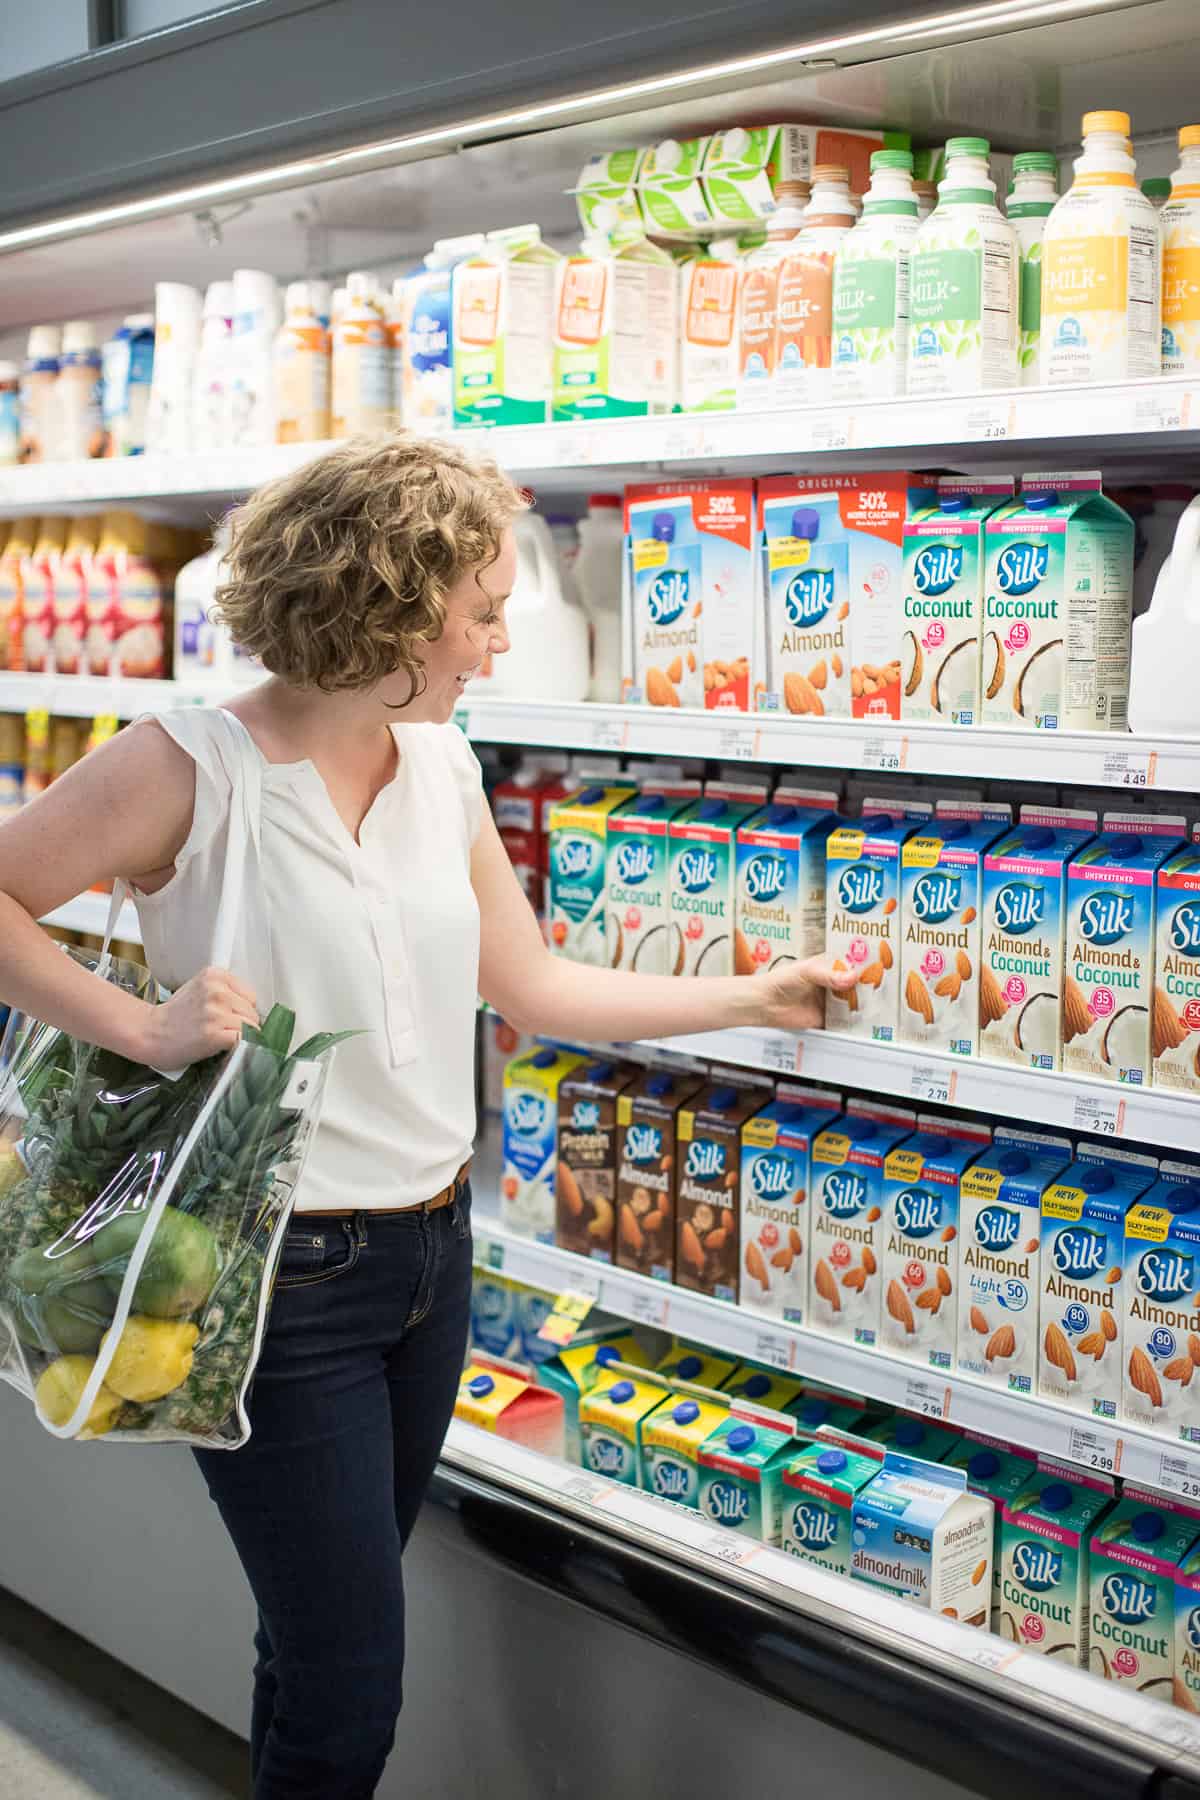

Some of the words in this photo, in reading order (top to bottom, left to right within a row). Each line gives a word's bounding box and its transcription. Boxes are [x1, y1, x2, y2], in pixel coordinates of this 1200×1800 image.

[1049, 268, 1095, 290] MILK
[797, 478, 859, 489] ORIGINAL
[709, 496, 736, 514] 50%
[858, 492, 887, 510] 50%
[914, 549, 962, 591] Silk
[997, 548, 1048, 590] Silk
[648, 572, 689, 624] Silk
[785, 572, 834, 627] Silk
[904, 597, 973, 618] Coconut
[987, 596, 1058, 619] Coconut
[642, 626, 697, 650] Almond
[779, 625, 844, 654] Almond
[929, 624, 943, 638] 45
[1011, 624, 1027, 639] 45
[559, 846, 593, 877] Silk
[616, 846, 655, 884] Silk
[678, 851, 717, 892] Silk
[746, 860, 784, 897] Silk
[838, 870, 882, 910] Silk
[1085, 872, 1134, 883] UNSWEETENED
[609, 884, 662, 907] Coconut
[671, 893, 725, 917] Coconut
[912, 878, 961, 919] Silk
[993, 887, 1045, 929] Silk
[741, 902, 784, 922] Almond
[831, 912, 891, 938] Almond
[1080, 897, 1134, 938] Silk
[742, 920, 791, 940] Coconut
[906, 923, 969, 949] Almond
[1170, 907, 1200, 950] Si
[988, 933, 1041, 957] Almond
[1073, 943, 1131, 969] Almond
[929, 954, 941, 965] 30
[991, 951, 1051, 977] Coconut
[1009, 979, 1023, 992] 35
[1075, 963, 1141, 989] Coconut
[1096, 991, 1111, 1005] 35
[572, 1102, 600, 1128] Silk
[1093, 1120, 1115, 1133] 2.79
[623, 1126, 662, 1161] Silk
[824, 1137, 843, 1145] NEW
[684, 1141, 726, 1177] Silk
[850, 1154, 879, 1166] ORIGINAL
[895, 1154, 916, 1164] NEW
[1077, 1155, 1105, 1166] VANILLA
[618, 1163, 669, 1192] Almond
[751, 1158, 793, 1194] Silk
[924, 1171, 954, 1182] ORIGINAL
[972, 1171, 996, 1183] NEW
[1162, 1174, 1190, 1185] VANILLA
[680, 1180, 733, 1209] Almond
[823, 1175, 867, 1211] Silk
[1054, 1189, 1078, 1201] NEW
[745, 1198, 800, 1226] Almond
[894, 1193, 943, 1231] Silk
[1059, 1204, 1080, 1215] SMOOTH
[1089, 1209, 1117, 1222] VANILLA
[1139, 1209, 1164, 1221] NEW
[816, 1215, 874, 1245] Almond
[975, 1206, 1019, 1244] Silk
[1127, 1222, 1143, 1231] SILKY
[1143, 1225, 1166, 1236] SMOOTH
[1175, 1231, 1200, 1243] VANILL
[887, 1236, 949, 1266] Almond
[964, 1247, 1030, 1280] Almond
[1053, 1232, 1107, 1272] Silk
[969, 1274, 1001, 1294] Light
[1136, 1253, 1194, 1295] Silk
[1007, 1283, 1023, 1298] 50
[1046, 1275, 1115, 1310] Almond
[1070, 1307, 1085, 1322] 80
[1155, 1331, 1170, 1346] 80
[590, 1443, 624, 1473] Silk
[1091, 1455, 1113, 1470] 2.99
[652, 1465, 690, 1496] Silk
[707, 1484, 750, 1520] Silk
[867, 1499, 893, 1511] VANILLA
[792, 1506, 837, 1546] Silk
[944, 1518, 986, 1545] almondmilk
[1017, 1520, 1063, 1542] UNSWEETENED
[853, 1550, 927, 1588] almondmilk
[1012, 1544, 1060, 1586] Silk
[1107, 1550, 1157, 1572] UNSWEETENED
[1003, 1579, 1072, 1626] Coconut
[1102, 1576, 1156, 1618] Silk
[1027, 1619, 1041, 1631] 45
[1093, 1613, 1168, 1658] Coconut
[1118, 1653, 1133, 1666] 45
